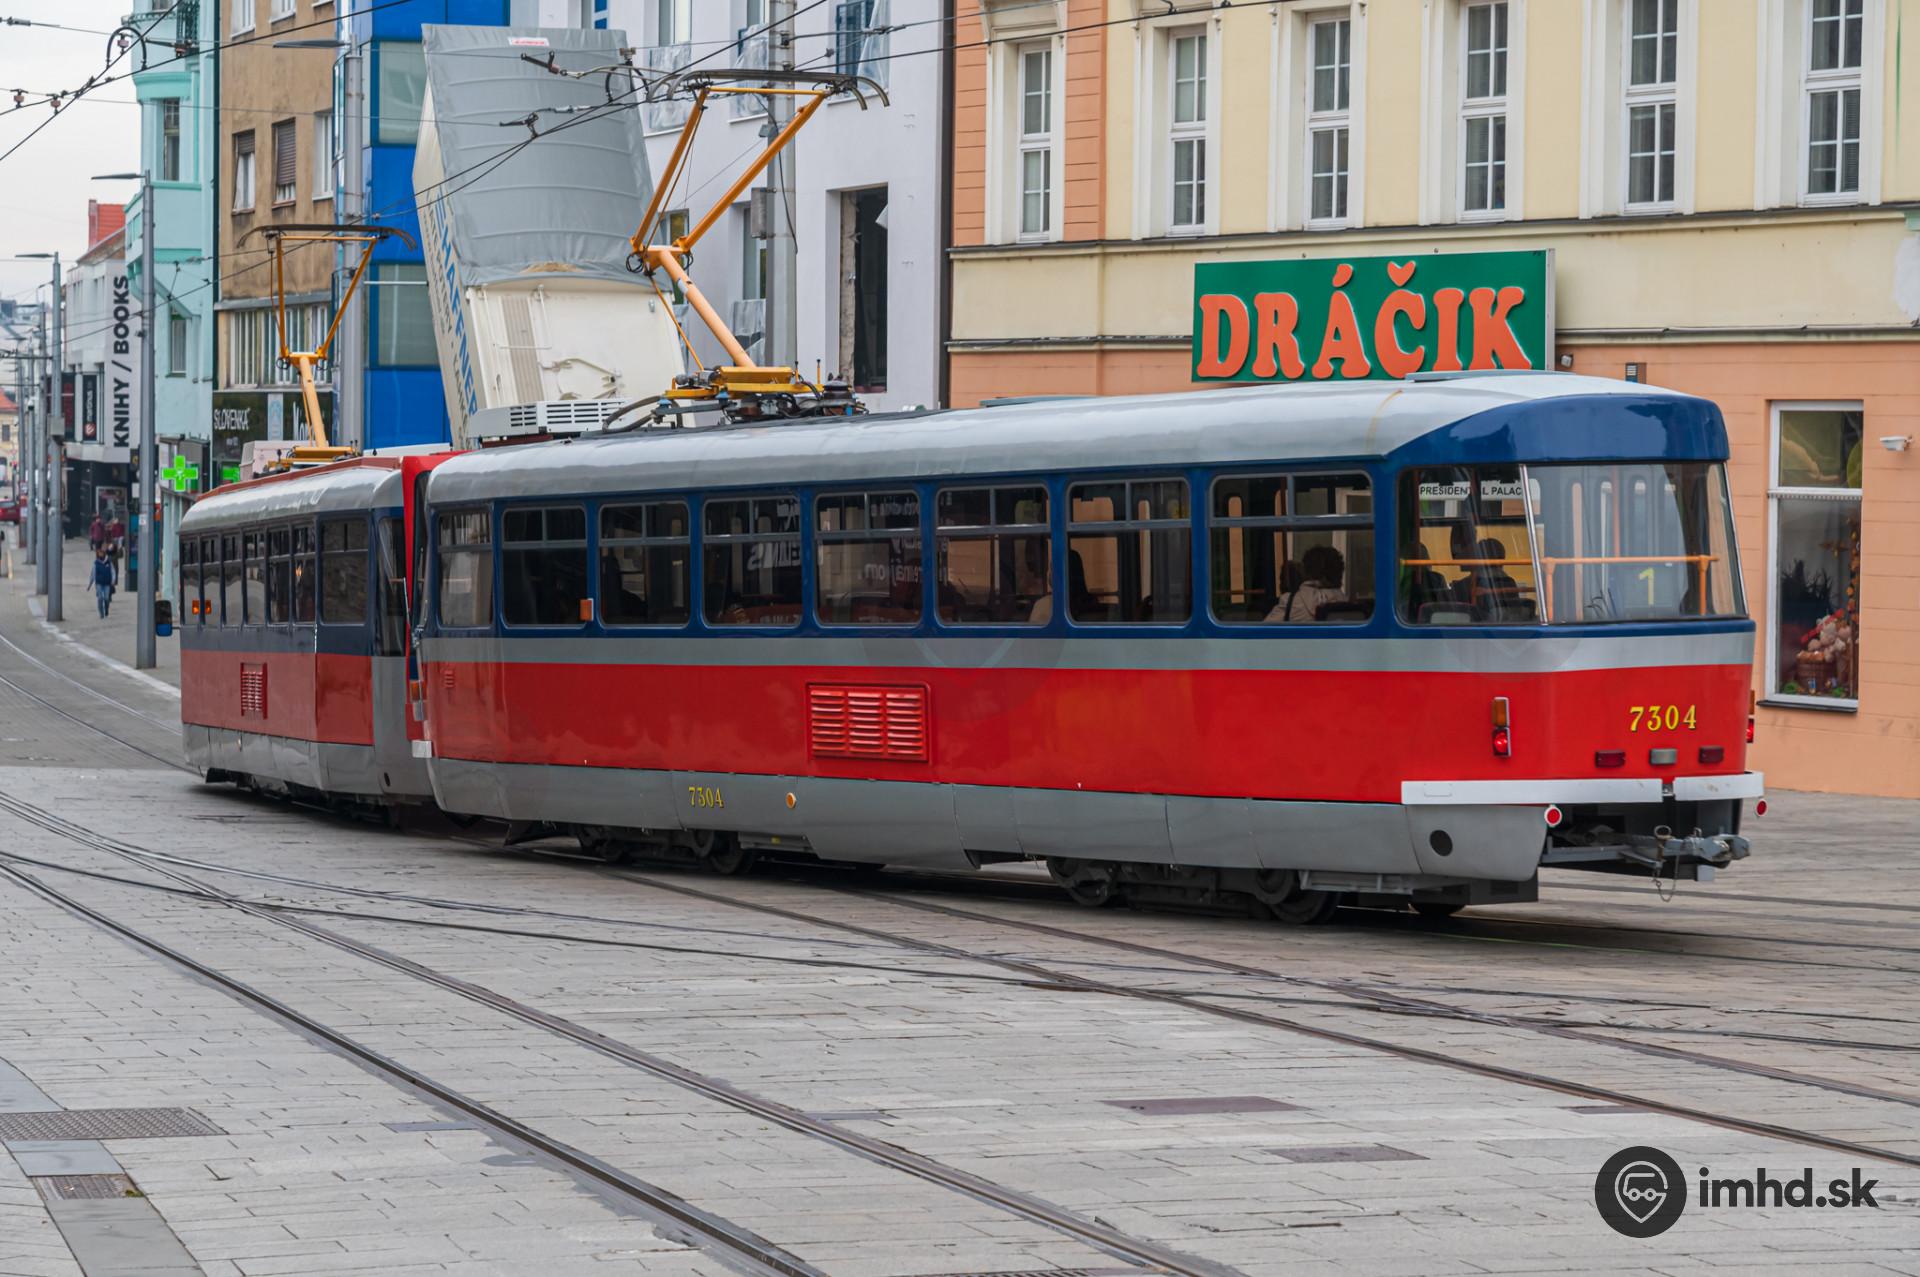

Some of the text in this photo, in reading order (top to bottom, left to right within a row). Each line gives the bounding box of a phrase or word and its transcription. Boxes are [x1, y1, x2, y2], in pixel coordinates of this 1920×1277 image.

[113, 275, 130, 354] BOOKS
[1197, 261, 1532, 378] DRÁČIK
[113, 378, 130, 448] KNIHY
[1491, 486, 1523, 496] PALAC
[1629, 705, 1698, 731] 7304
[688, 786, 725, 808] 7304
